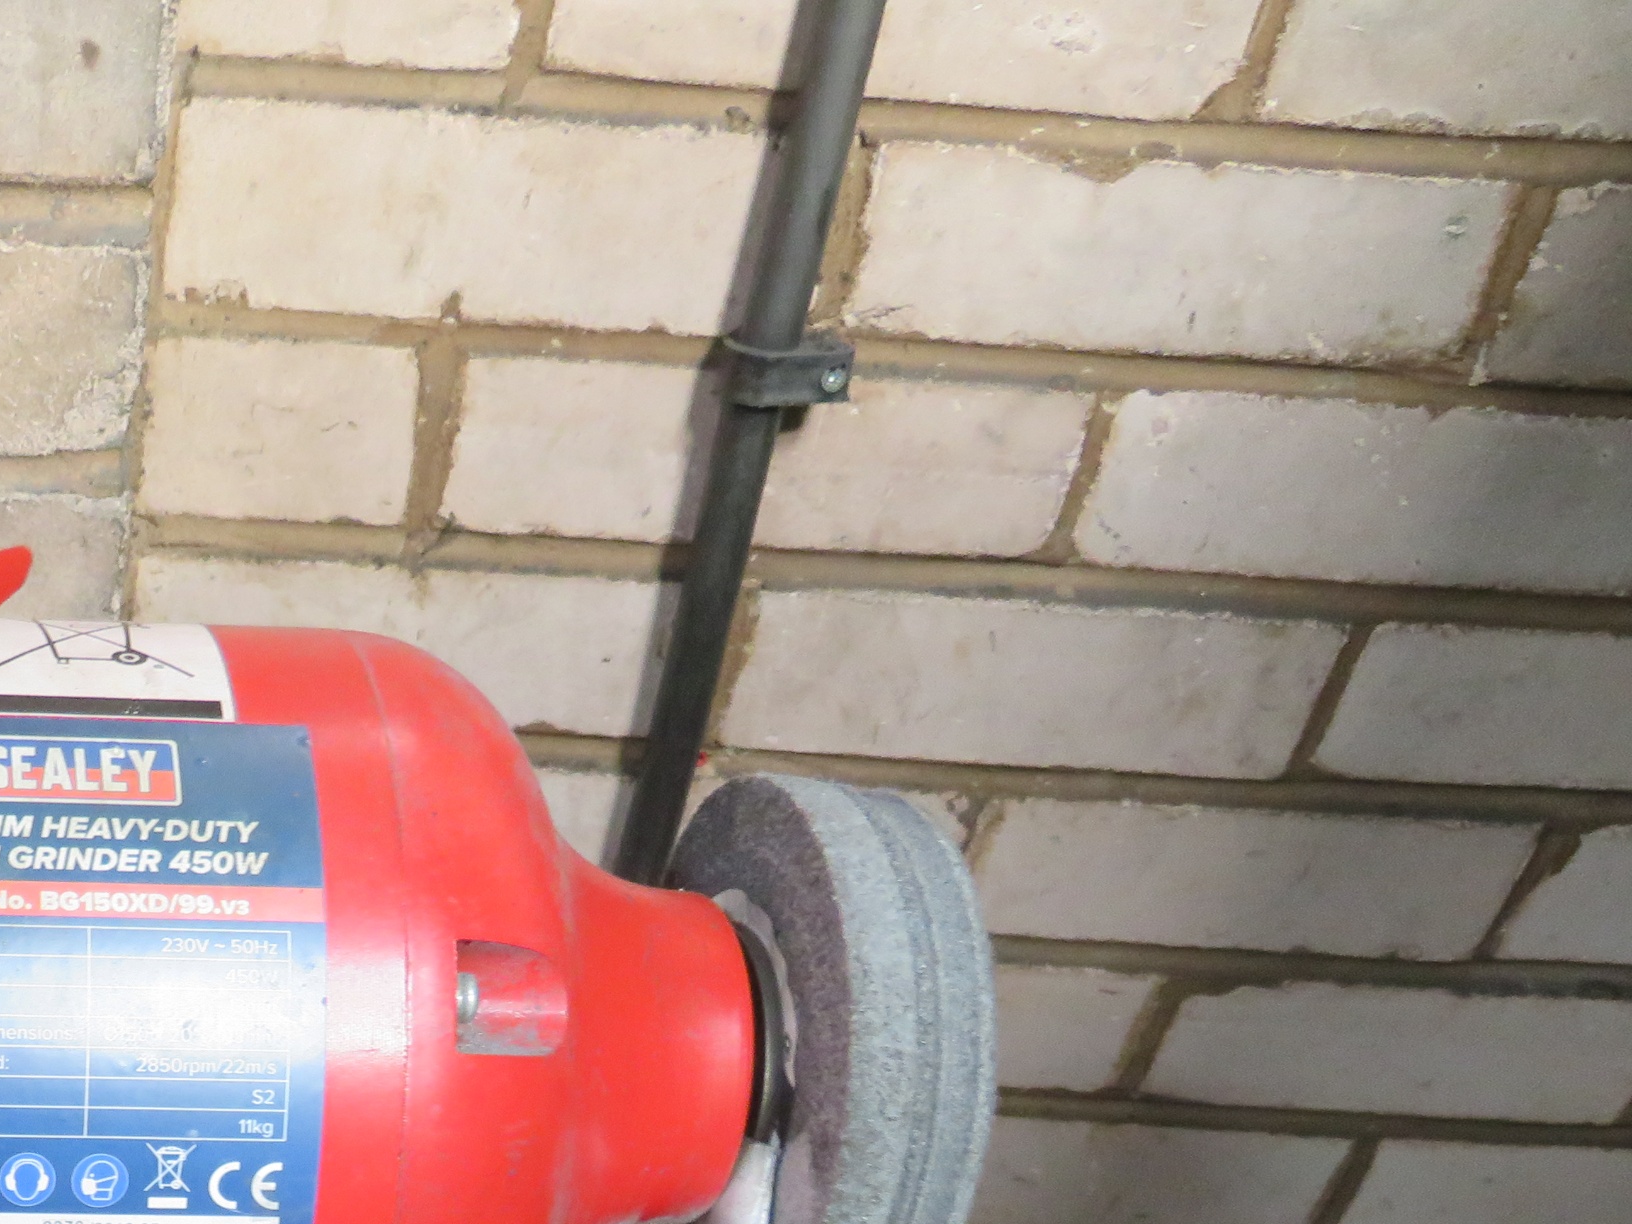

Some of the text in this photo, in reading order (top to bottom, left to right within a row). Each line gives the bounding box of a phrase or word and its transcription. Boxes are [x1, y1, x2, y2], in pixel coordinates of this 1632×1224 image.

[41, 816, 259, 843] HEAVY-DUTY
[8, 846, 162, 873] GRINDER
[168, 850, 269, 875] 450W
[161, 937, 210, 955] 230V
[230, 938, 279, 955] 50Hz
[135, 1057, 277, 1076] 2850rpm/22m/s
[251, 1089, 275, 1105] S2
[238, 1118, 275, 1137] 11kg
